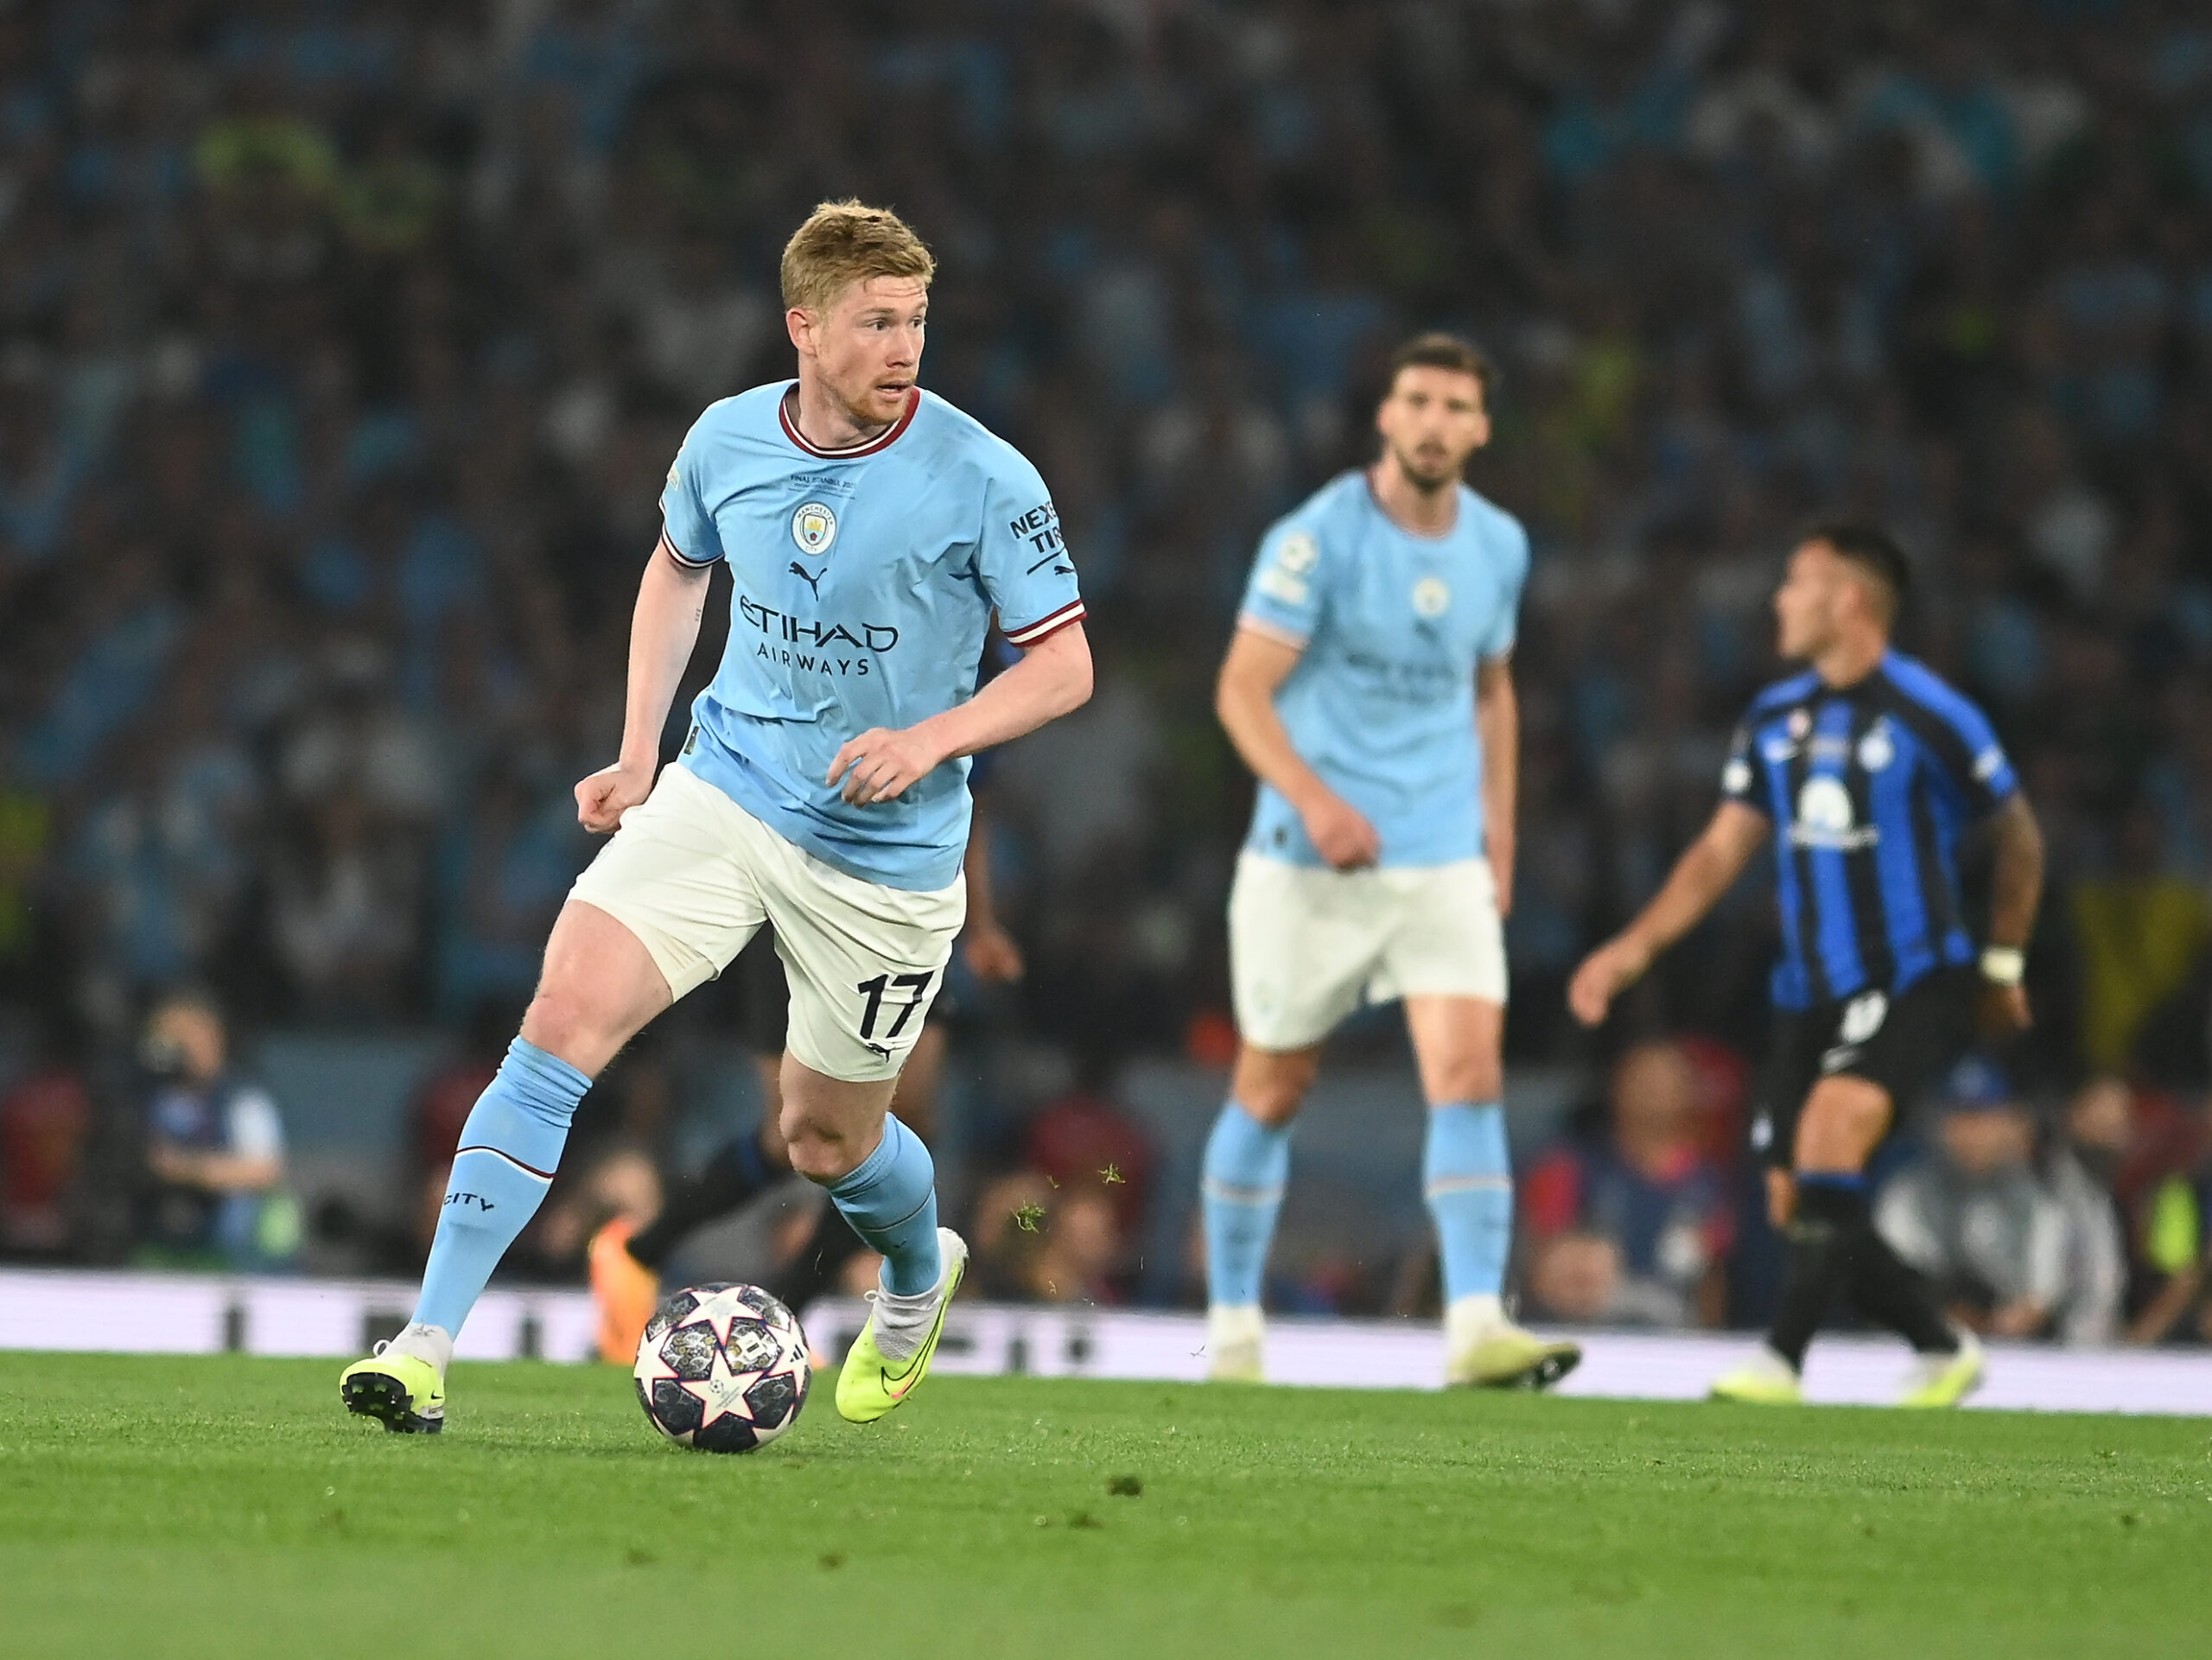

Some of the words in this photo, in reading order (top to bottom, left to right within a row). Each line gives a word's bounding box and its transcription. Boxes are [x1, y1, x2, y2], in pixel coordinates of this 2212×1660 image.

[798, 506, 833, 525] MANCHESTER
[741, 595, 899, 653] ETIHAD
[757, 642, 868, 676] AIRWAYS
[857, 970, 935, 1040] 17
[443, 1193, 494, 1212] CITY
